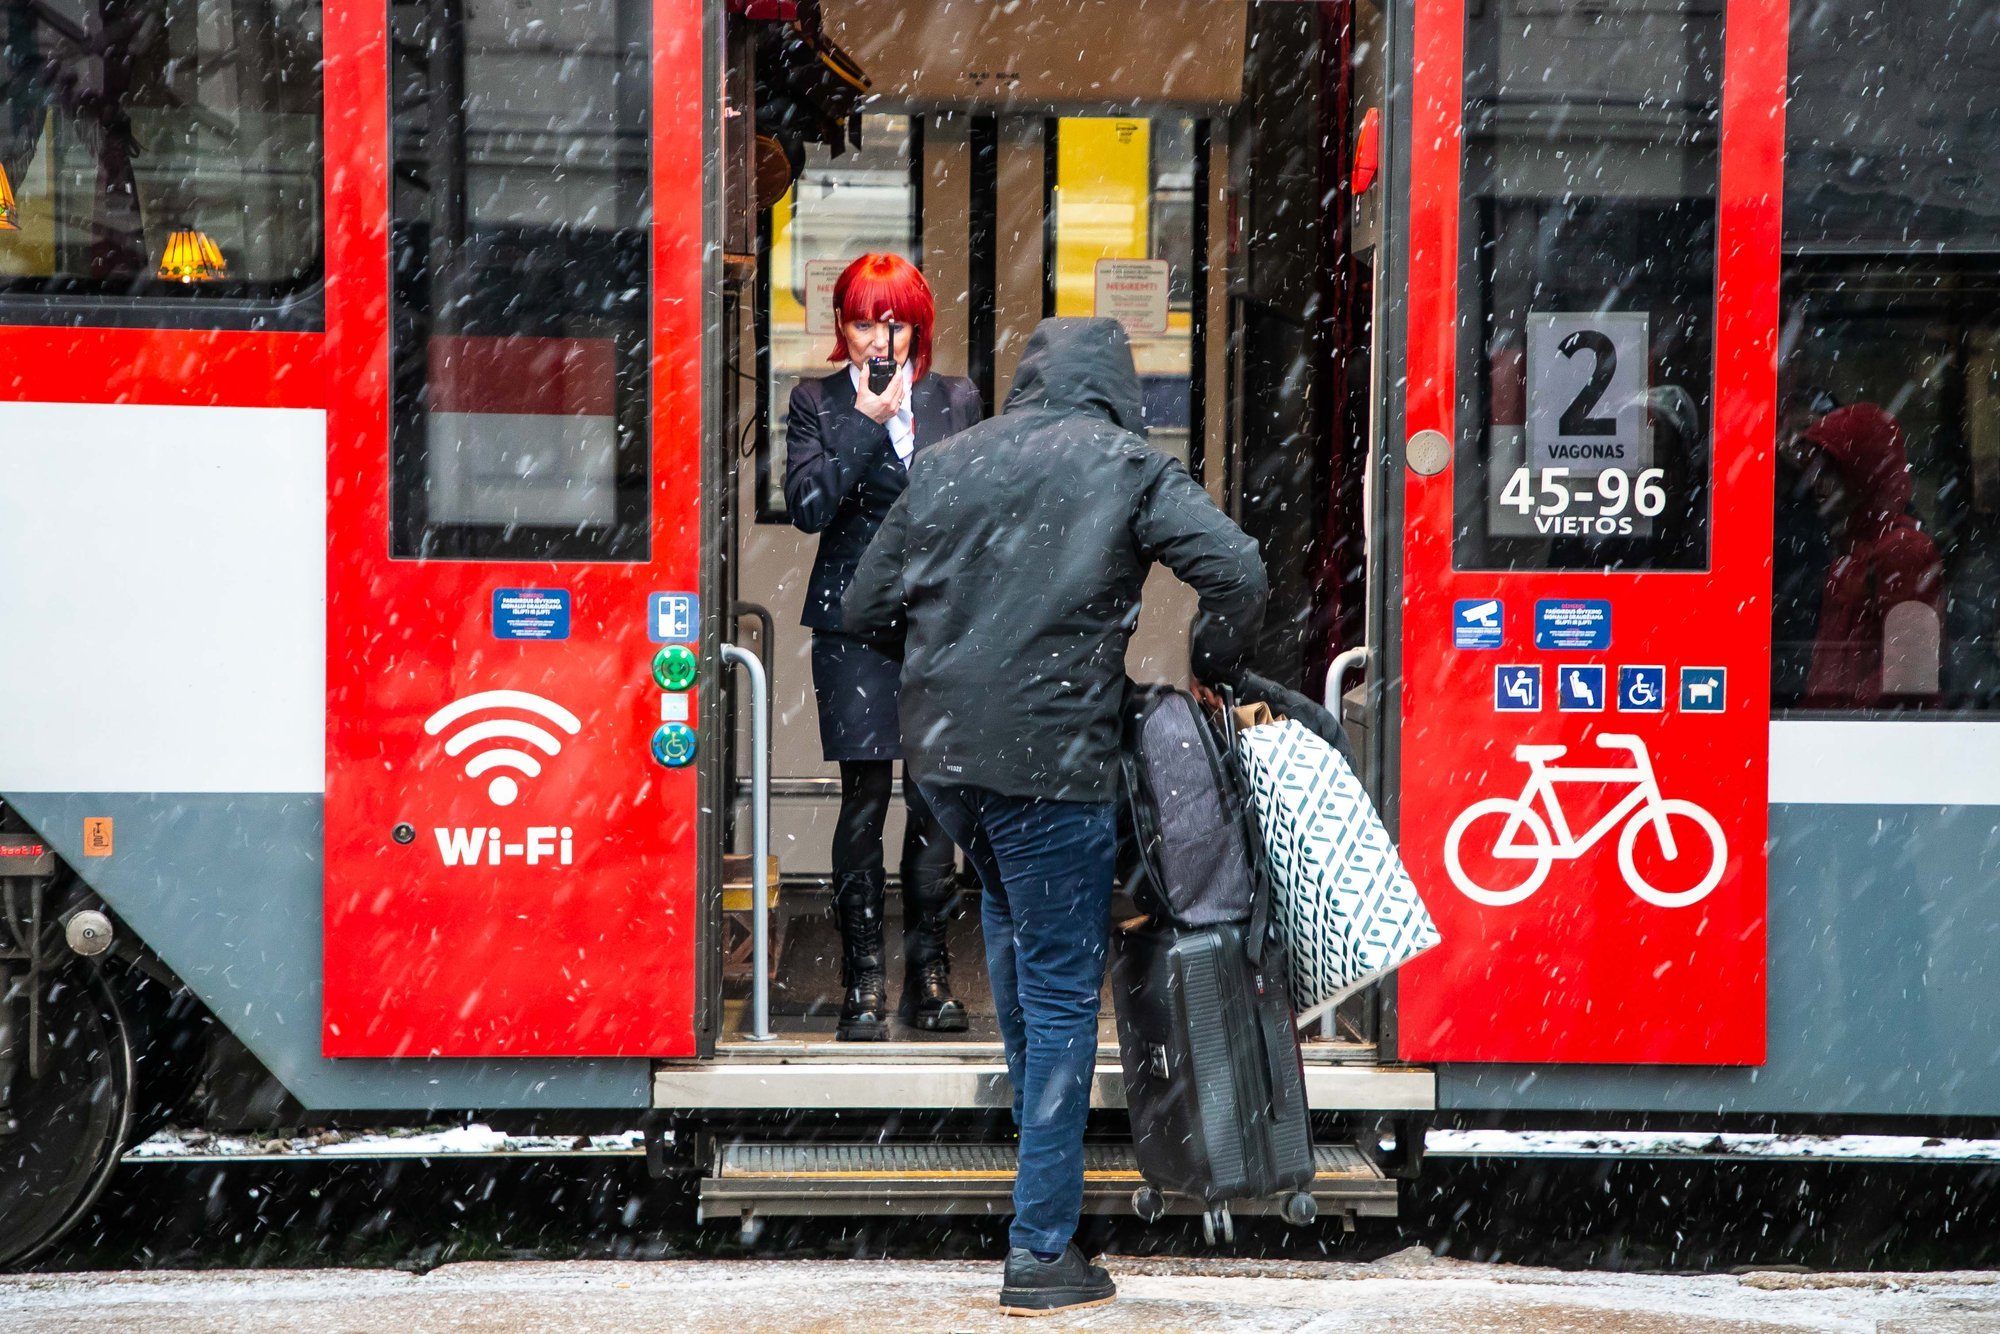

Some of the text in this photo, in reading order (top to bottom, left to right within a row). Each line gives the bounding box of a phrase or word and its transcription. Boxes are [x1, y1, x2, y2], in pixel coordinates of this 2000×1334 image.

[1558, 330, 1617, 436] 2
[1548, 444, 1625, 459] VAGONAS
[1500, 467, 1666, 517] 45-96
[1534, 516, 1633, 535] VIETOS
[434, 826, 573, 866] Wi-Fi
